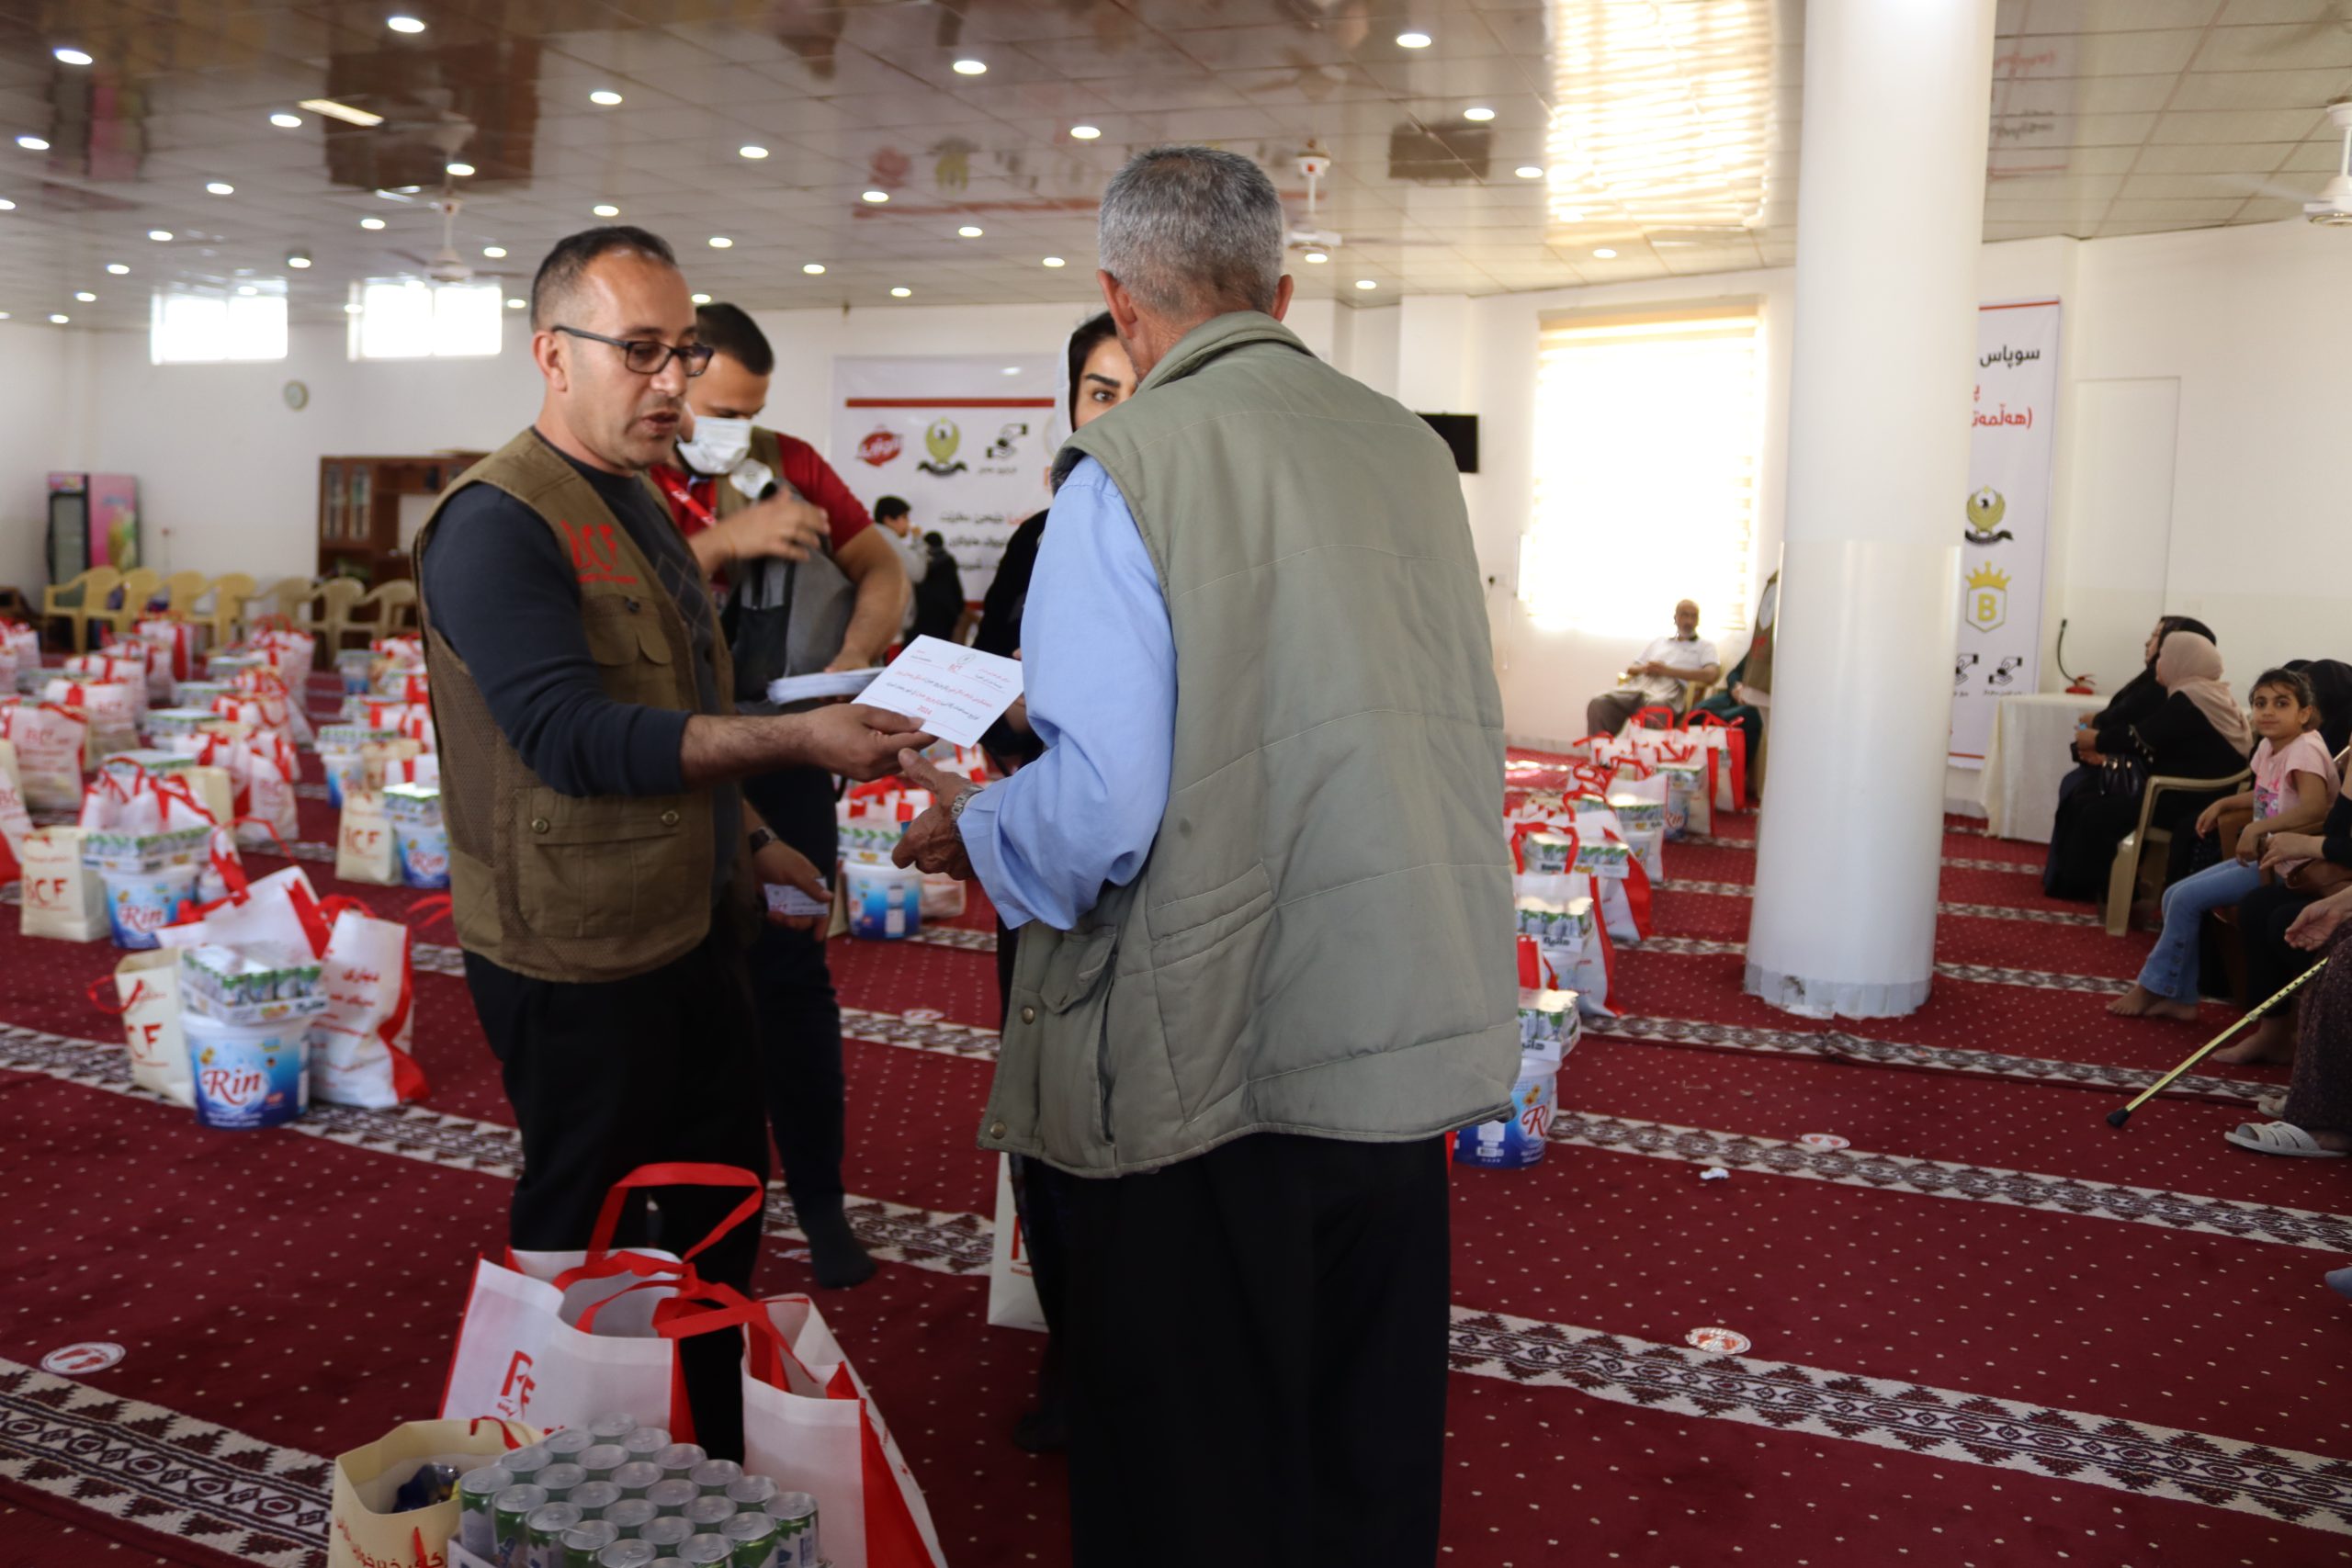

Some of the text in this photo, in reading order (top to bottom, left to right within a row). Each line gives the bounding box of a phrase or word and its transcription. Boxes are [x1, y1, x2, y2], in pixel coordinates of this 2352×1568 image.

[1979, 344, 2041, 369] سوپاس
[1977, 593, 1997, 621] B
[118, 906, 163, 931] Rin
[202, 1069, 262, 1106] Rin
